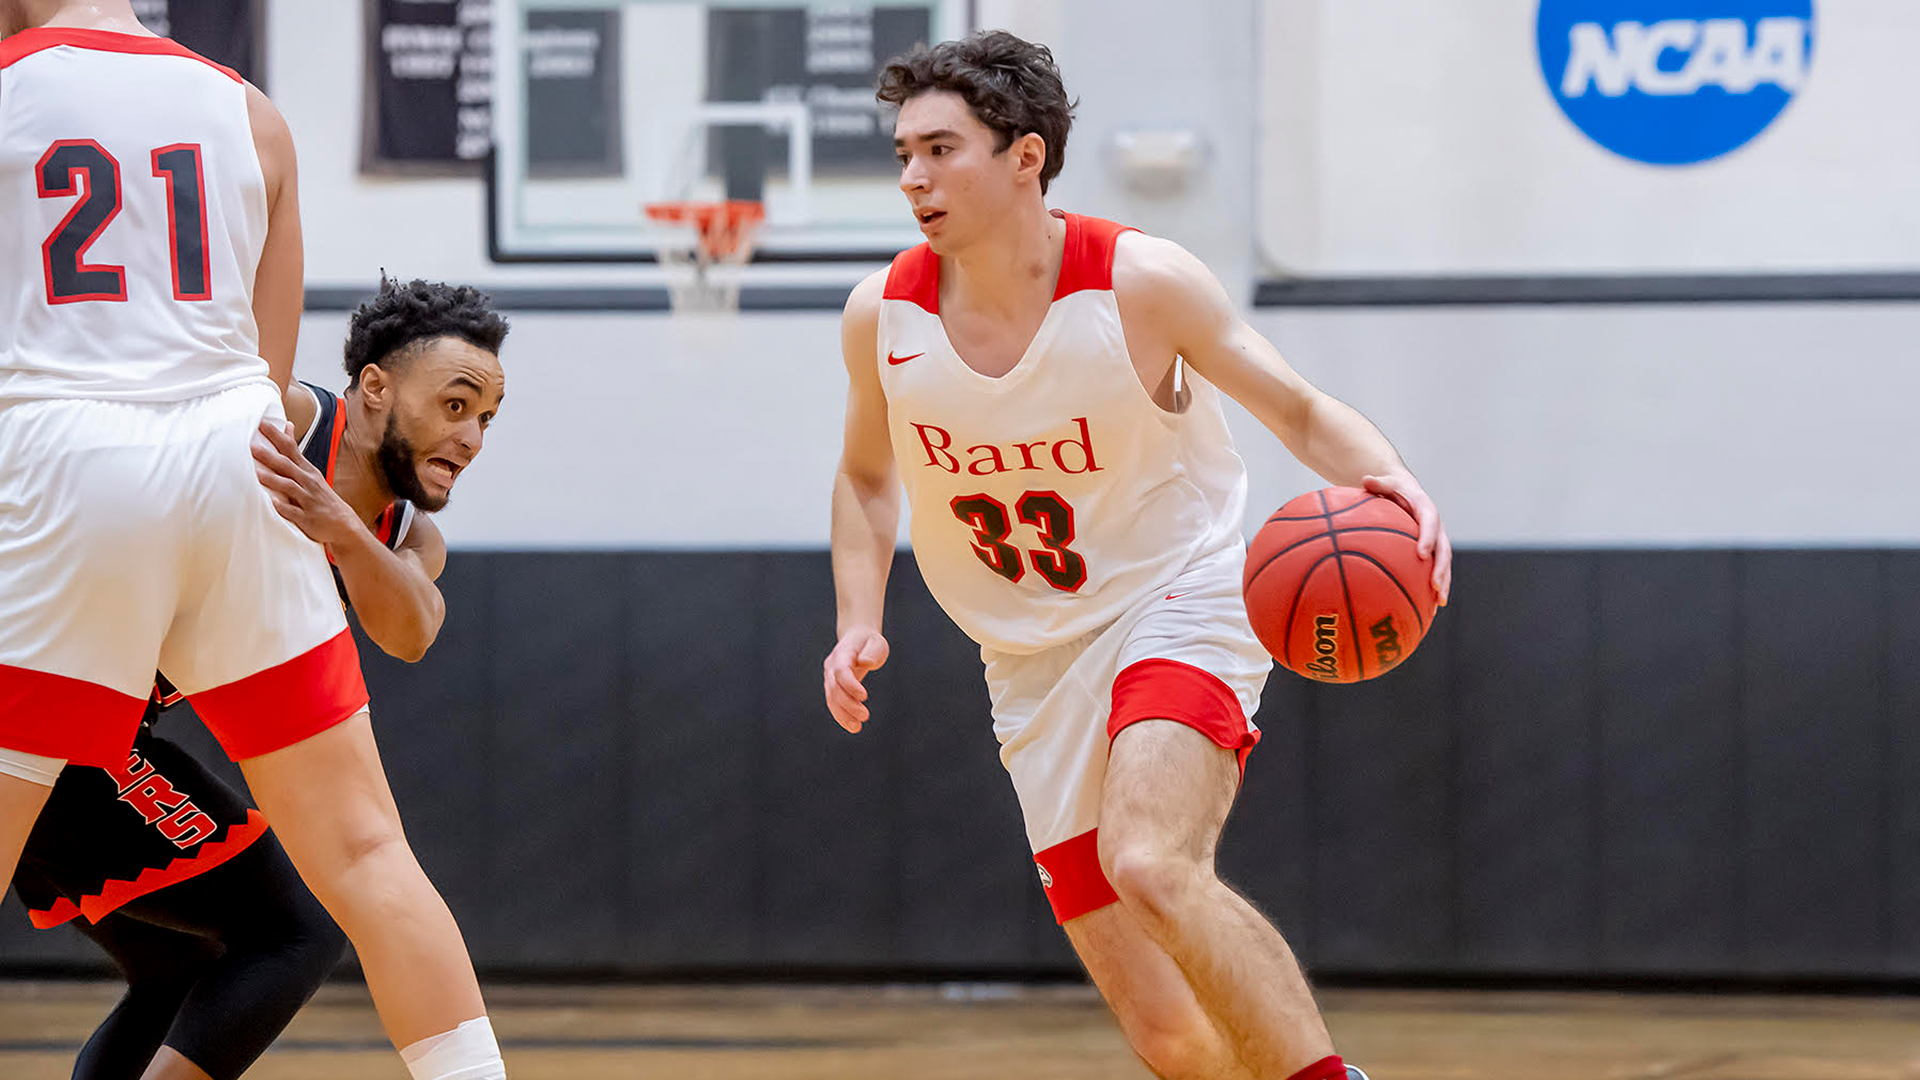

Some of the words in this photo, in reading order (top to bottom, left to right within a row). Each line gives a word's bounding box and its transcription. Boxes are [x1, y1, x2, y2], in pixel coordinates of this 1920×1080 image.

[1560, 17, 1806, 98] NCAA
[34, 138, 212, 305] 21
[909, 416, 1104, 476] Bard
[949, 490, 1088, 593] 33
[1370, 614, 1402, 669] CAA
